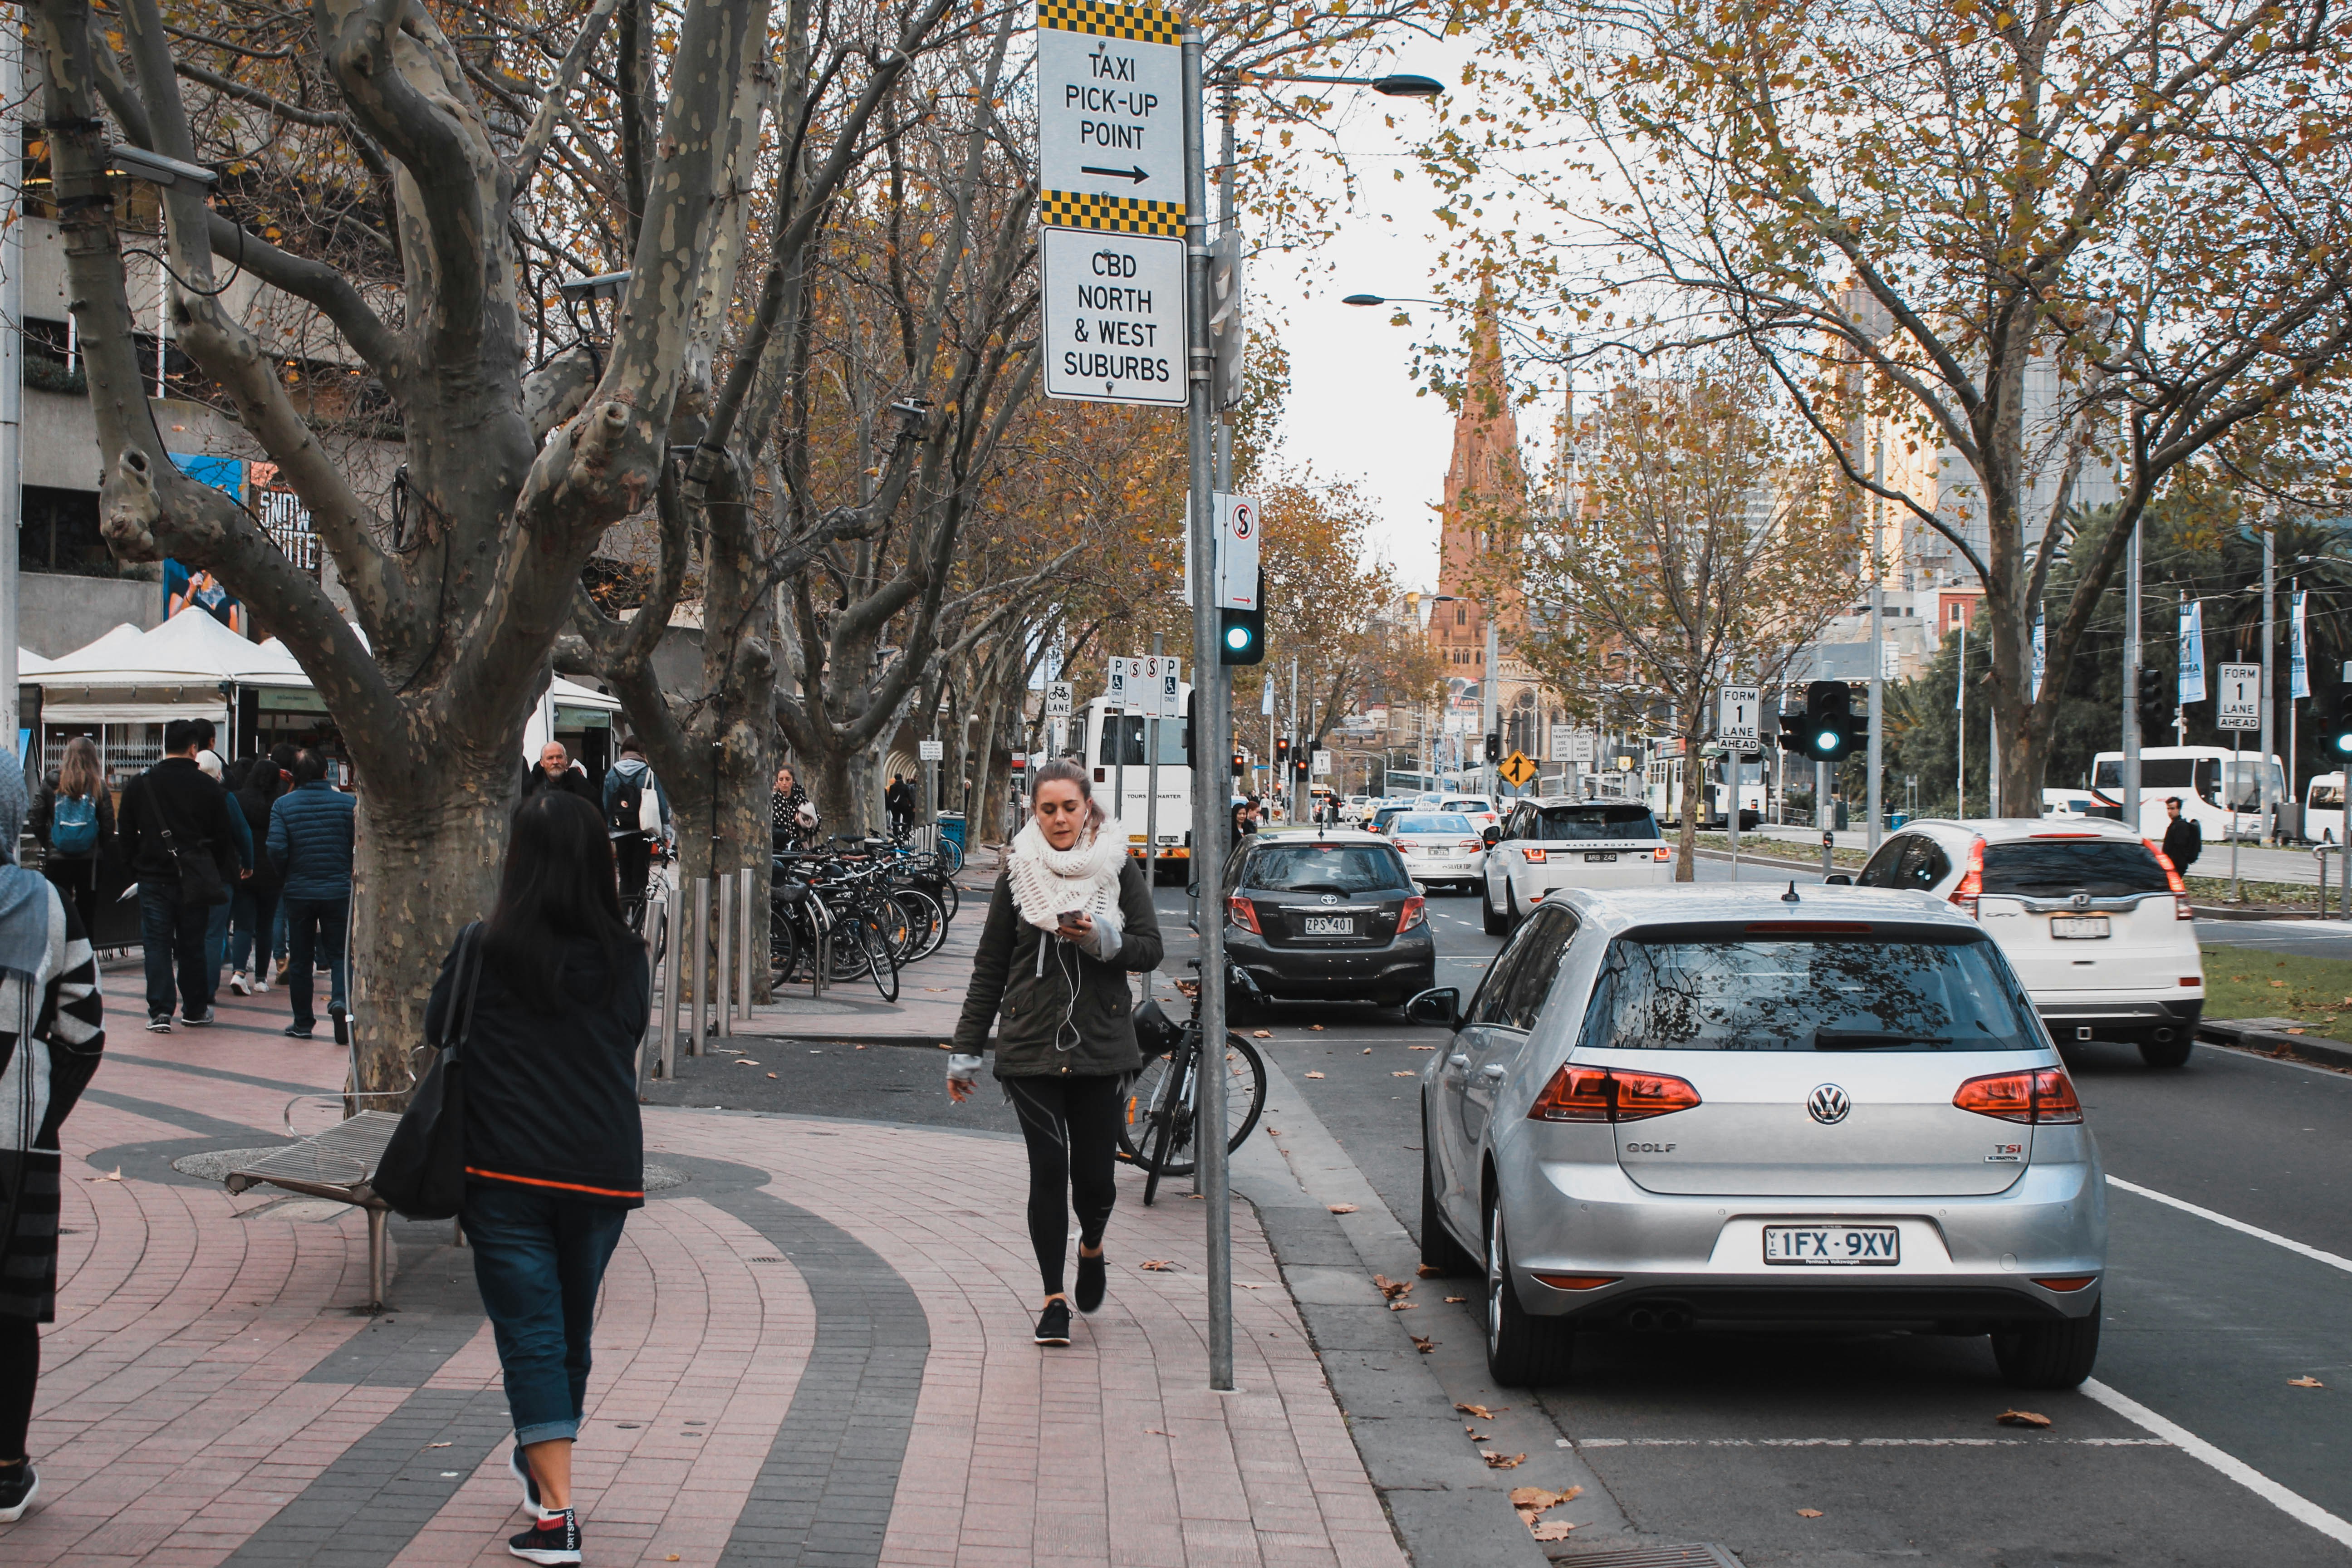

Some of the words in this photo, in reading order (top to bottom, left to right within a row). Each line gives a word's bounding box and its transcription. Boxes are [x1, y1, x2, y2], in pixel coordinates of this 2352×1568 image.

[1088, 53, 1135, 82] TAXI
[1066, 84, 1158, 118] PICK-UP
[1081, 120, 1145, 150] POINT
[1092, 252, 1137, 279] CBD
[1078, 284, 1152, 314] NORTH
[1074, 318, 1088, 343] &
[1098, 321, 1157, 348] WEST
[1064, 352, 1170, 382] SUBURBS
[1115, 660, 1122, 672] P
[1168, 660, 1175, 674] P
[2225, 669, 2255, 678] FORM
[1725, 691, 1755, 701] FORM
[2236, 682, 2243, 700] 1
[1737, 705, 1743, 723] 1
[2224, 704, 2254, 714] LANE
[2220, 719, 2257, 727] AHEAD
[1724, 727, 1754, 736] LANE
[1720, 740, 1757, 748] AHEAD
[1307, 919, 1326, 930] ZPS
[1333, 920, 1351, 930] 401
[1626, 1142, 1676, 1153] GOLF
[1995, 1144, 2022, 1153] TSI
